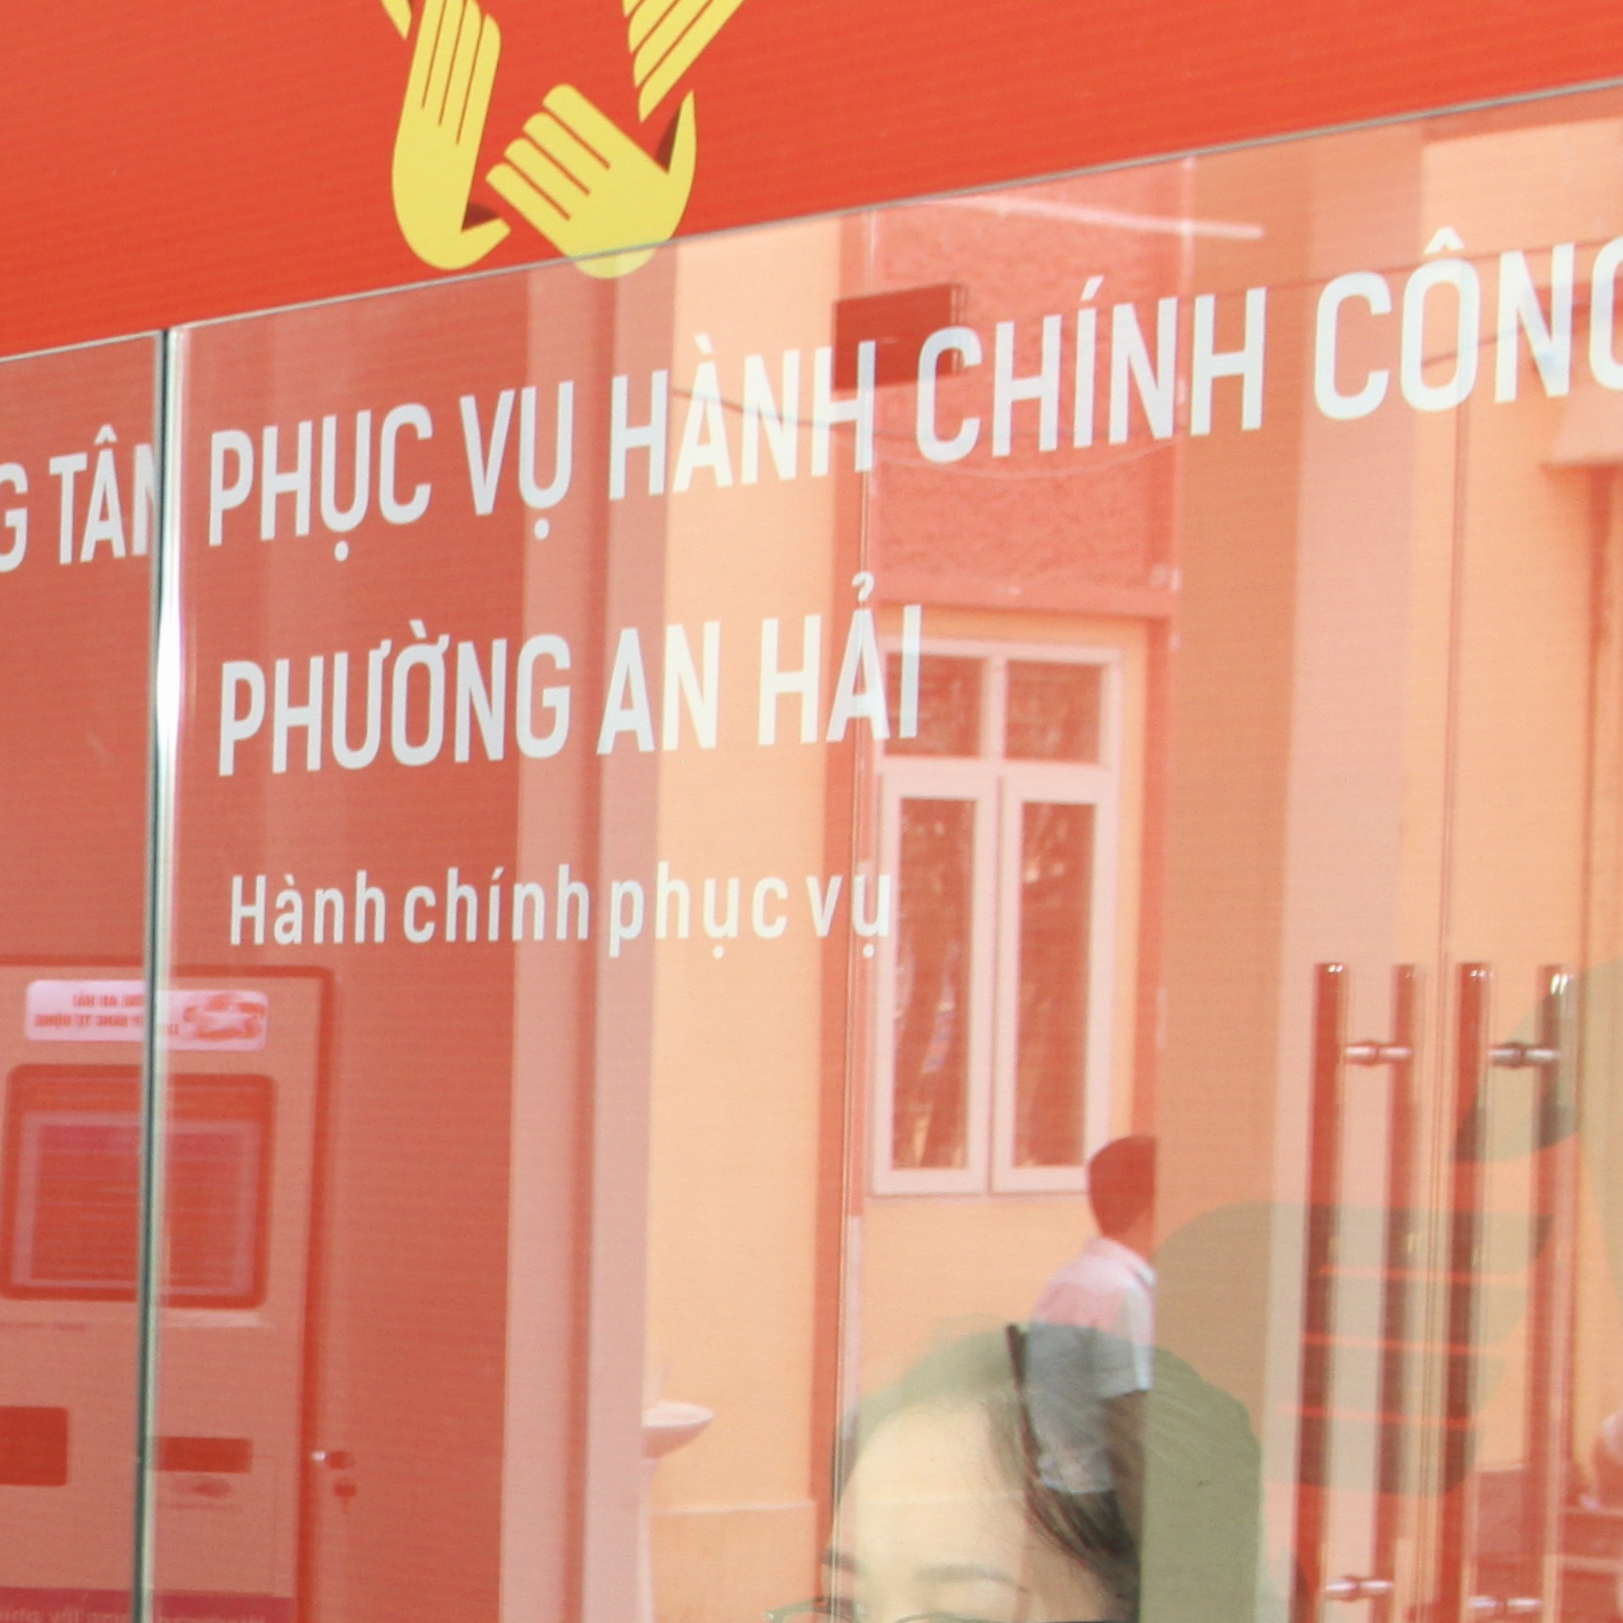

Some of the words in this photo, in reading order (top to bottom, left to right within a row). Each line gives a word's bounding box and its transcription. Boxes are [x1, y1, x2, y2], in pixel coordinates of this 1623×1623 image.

[207, 401, 432, 562] PHỤC
[460, 380, 574, 541] VỤ
[608, 333, 876, 503] HÀNH
[915, 276, 1267, 464] CHÍNH
[218, 619, 571, 777] PHƯỜNG
[598, 619, 721, 757] AN
[758, 571, 922, 748] HẢI
[228, 870, 386, 947] Hành
[402, 862, 590, 945] chính
[608, 858, 788, 962] phục
[805, 872, 892, 960] vụ
